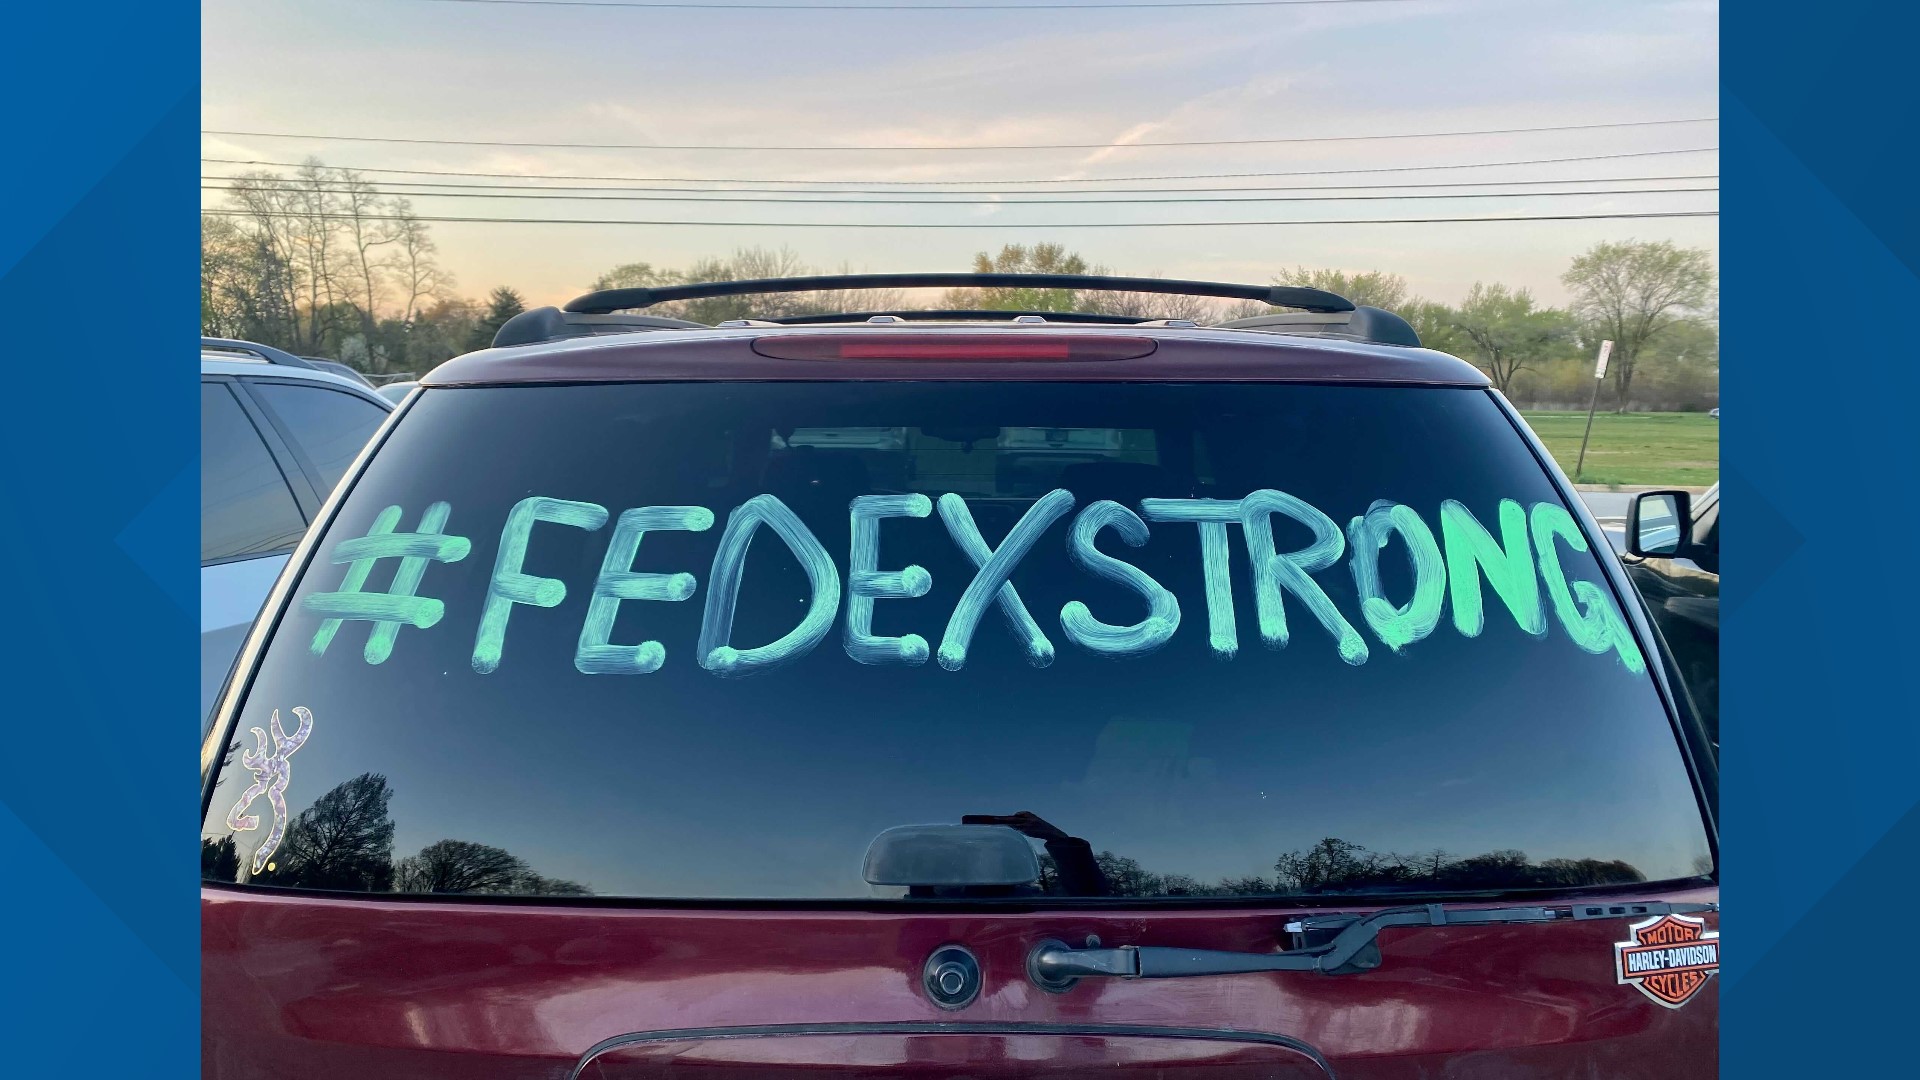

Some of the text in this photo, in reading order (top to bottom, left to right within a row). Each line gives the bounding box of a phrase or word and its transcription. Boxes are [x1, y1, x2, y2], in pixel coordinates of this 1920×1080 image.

[304, 489, 1646, 675] #FEDEXSTRONG
[1646, 921, 1694, 945] MOTOR
[1628, 944, 1717, 972] HARLEY-DAVIDSON
[1651, 971, 1698, 997] CYCLES
